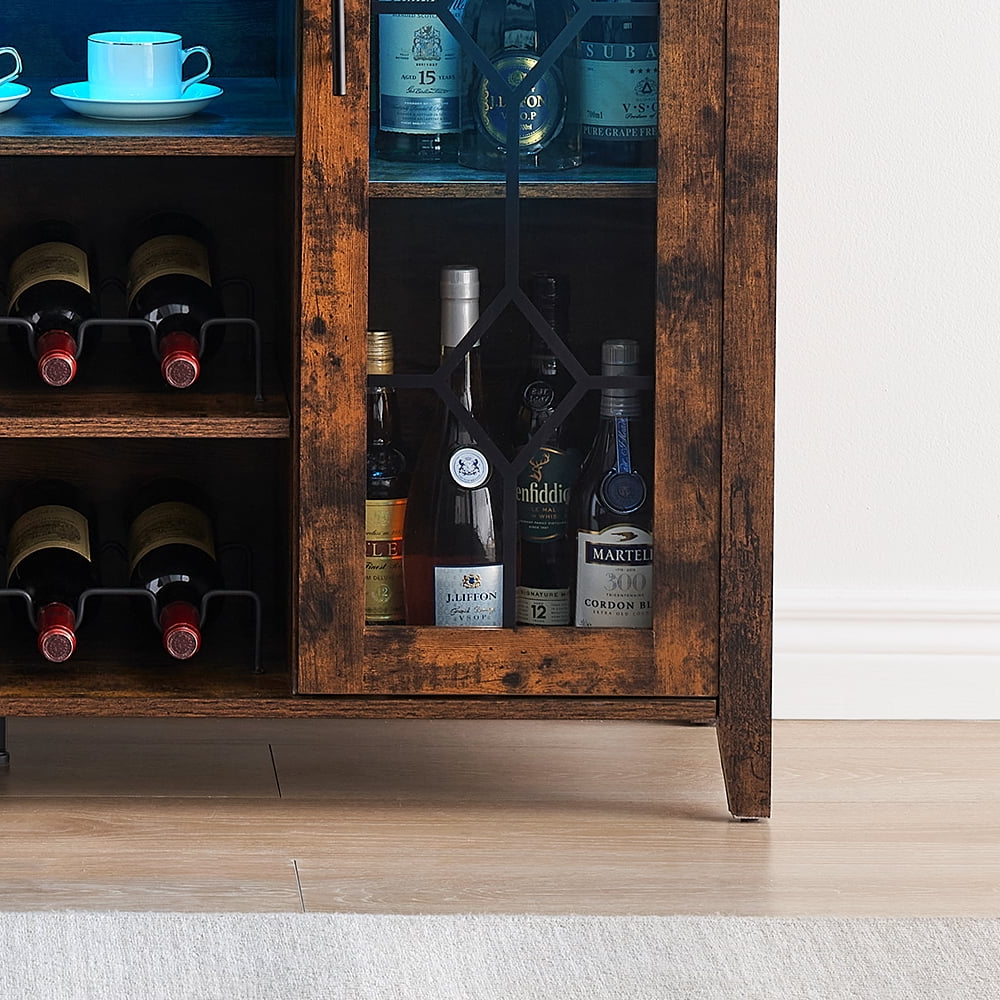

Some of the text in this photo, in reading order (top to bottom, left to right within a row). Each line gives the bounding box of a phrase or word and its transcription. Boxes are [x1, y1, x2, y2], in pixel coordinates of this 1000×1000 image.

[418, 70, 436, 85] 15
[583, 126, 604, 136] PURE
[605, 127, 638, 136] GRAPE
[604, 572, 647, 591] 300
[446, 592, 497, 603] J.LIFFON
[584, 598, 634, 610] CORDON
[531, 604, 547, 619] 12
